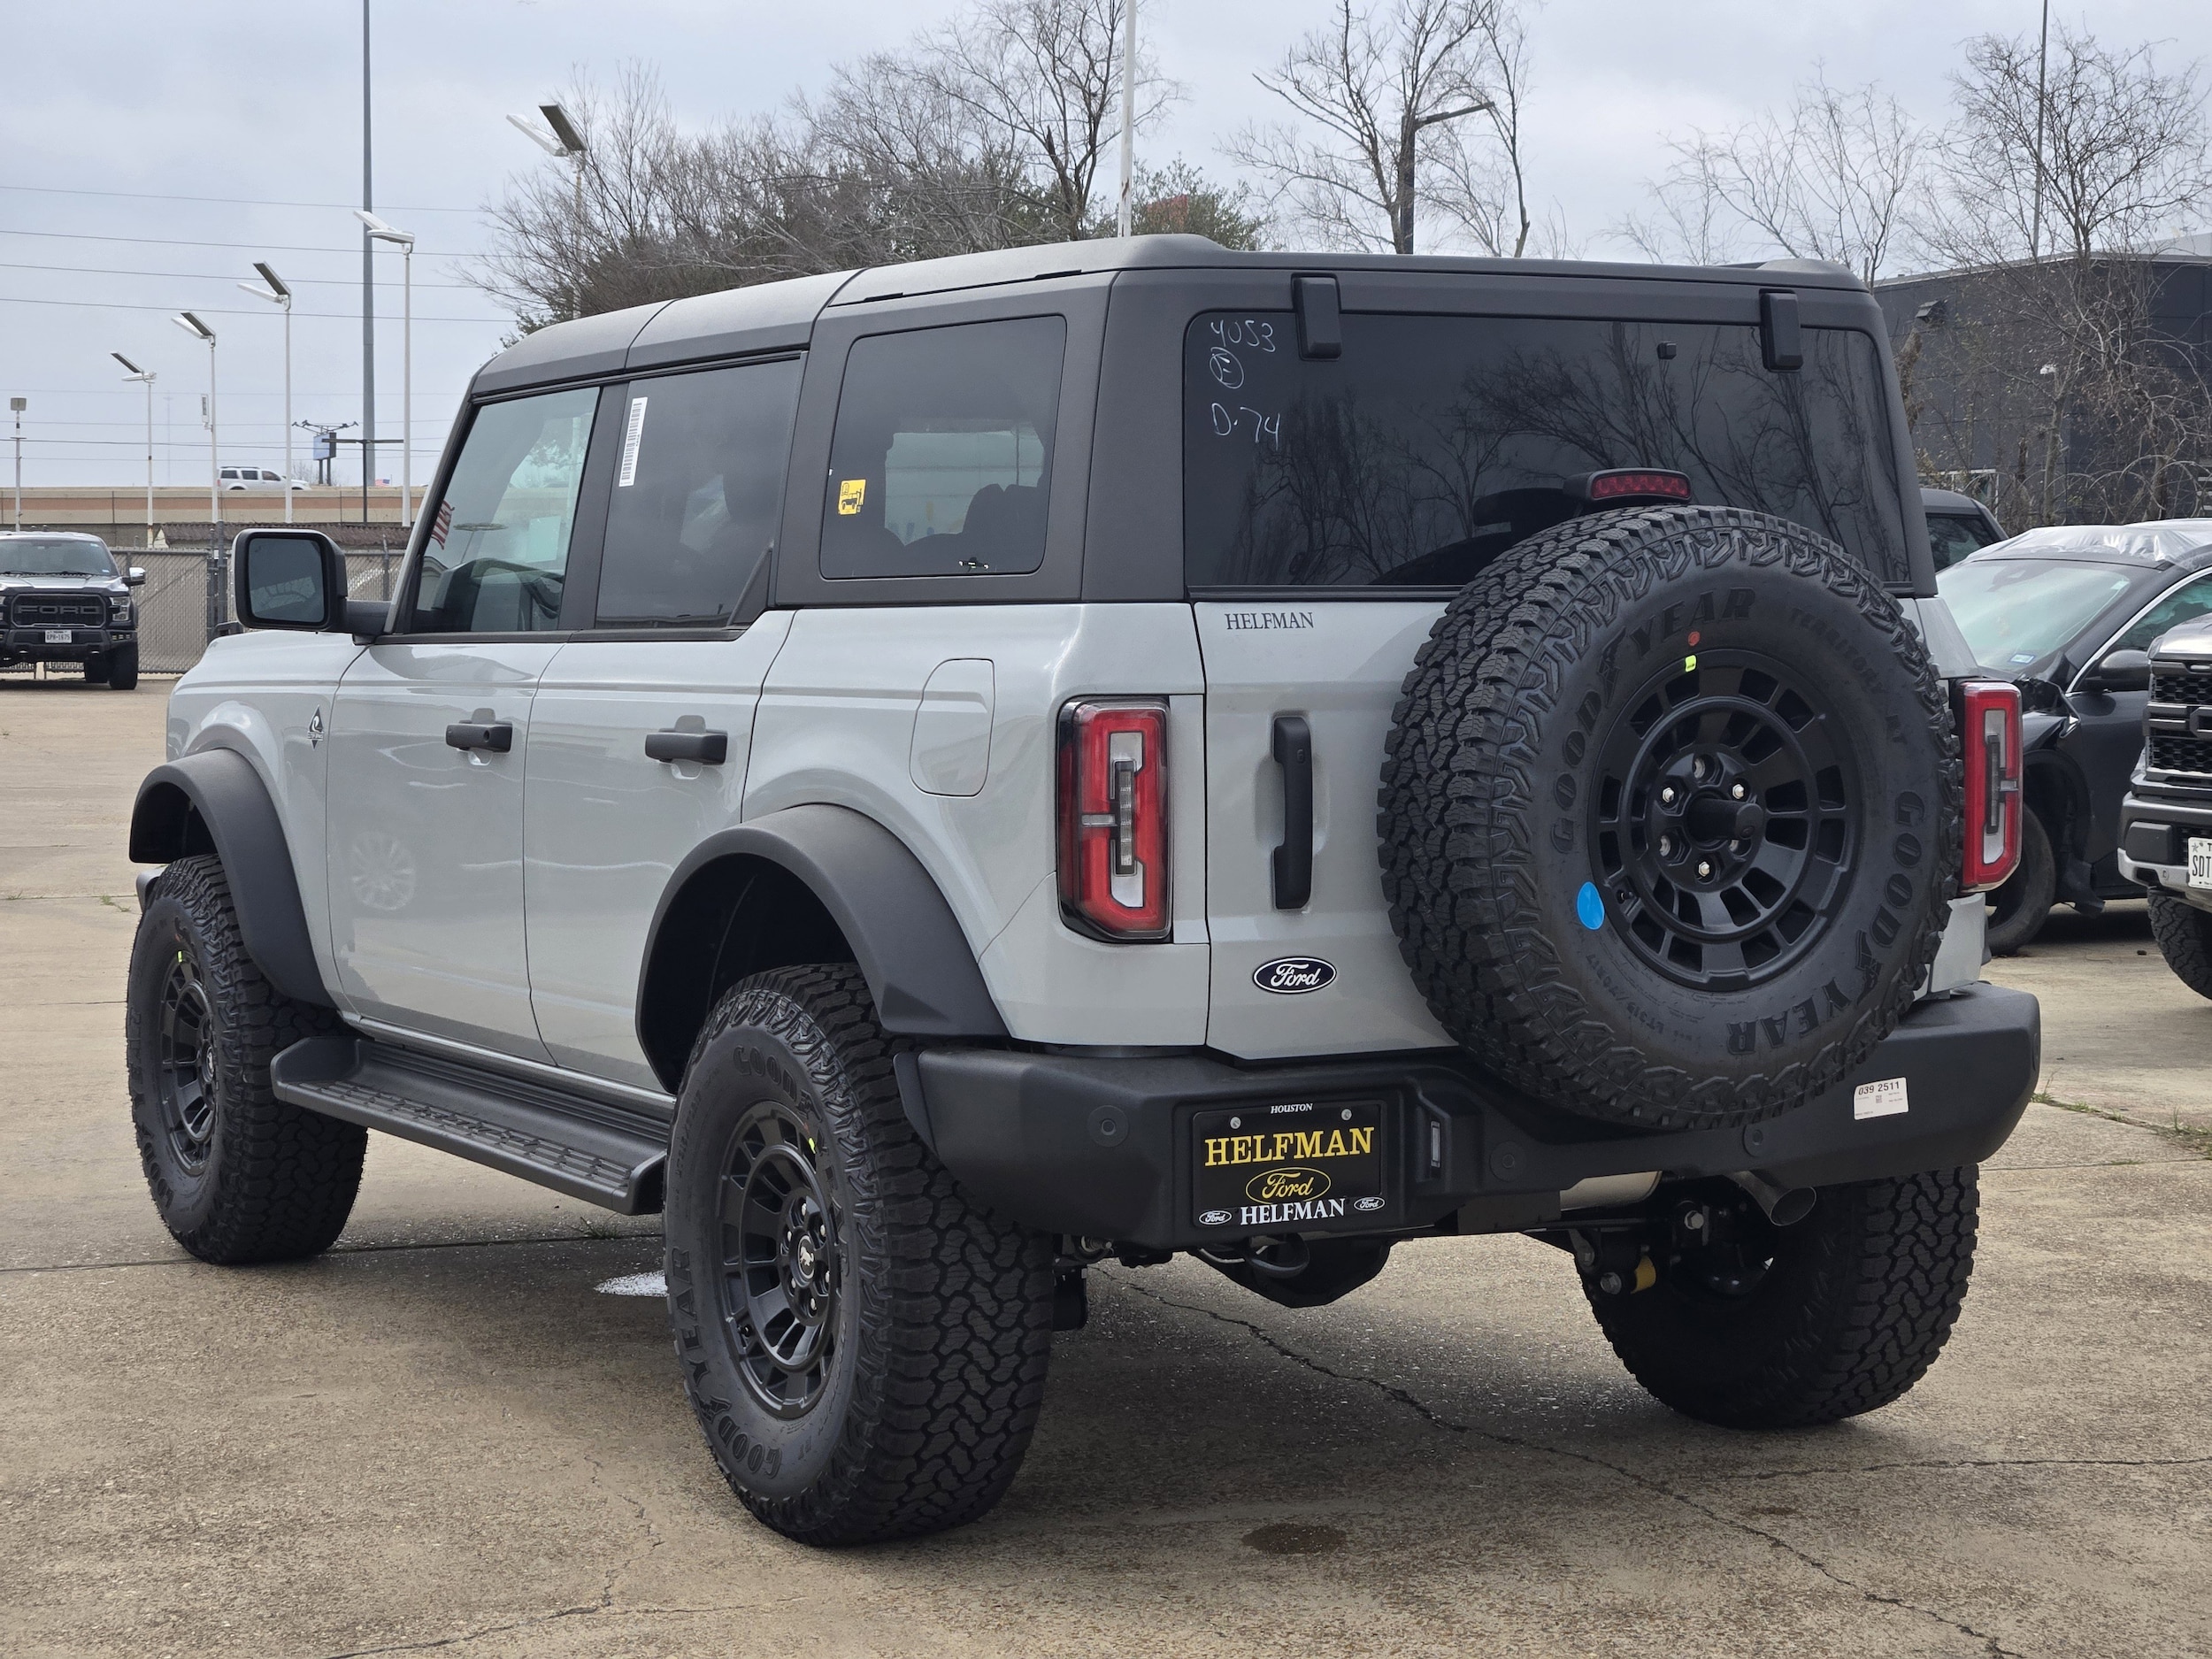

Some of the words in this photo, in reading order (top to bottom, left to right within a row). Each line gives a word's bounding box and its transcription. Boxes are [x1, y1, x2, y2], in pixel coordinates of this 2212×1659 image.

[1210, 319, 1276, 353] 4053
[17, 605, 101, 615] FORD
[1225, 611, 1315, 630] HELFMAN
[1270, 963, 1322, 987] Ford
[1858, 1085, 1875, 1095] 039
[1878, 1080, 1900, 1092] 2511
[1271, 1102, 1314, 1115] HOUSTON
[1204, 1126, 1375, 1167] HELFMAN
[1261, 1171, 1315, 1199] Ford
[1240, 1198, 1346, 1226] HELFMAN
